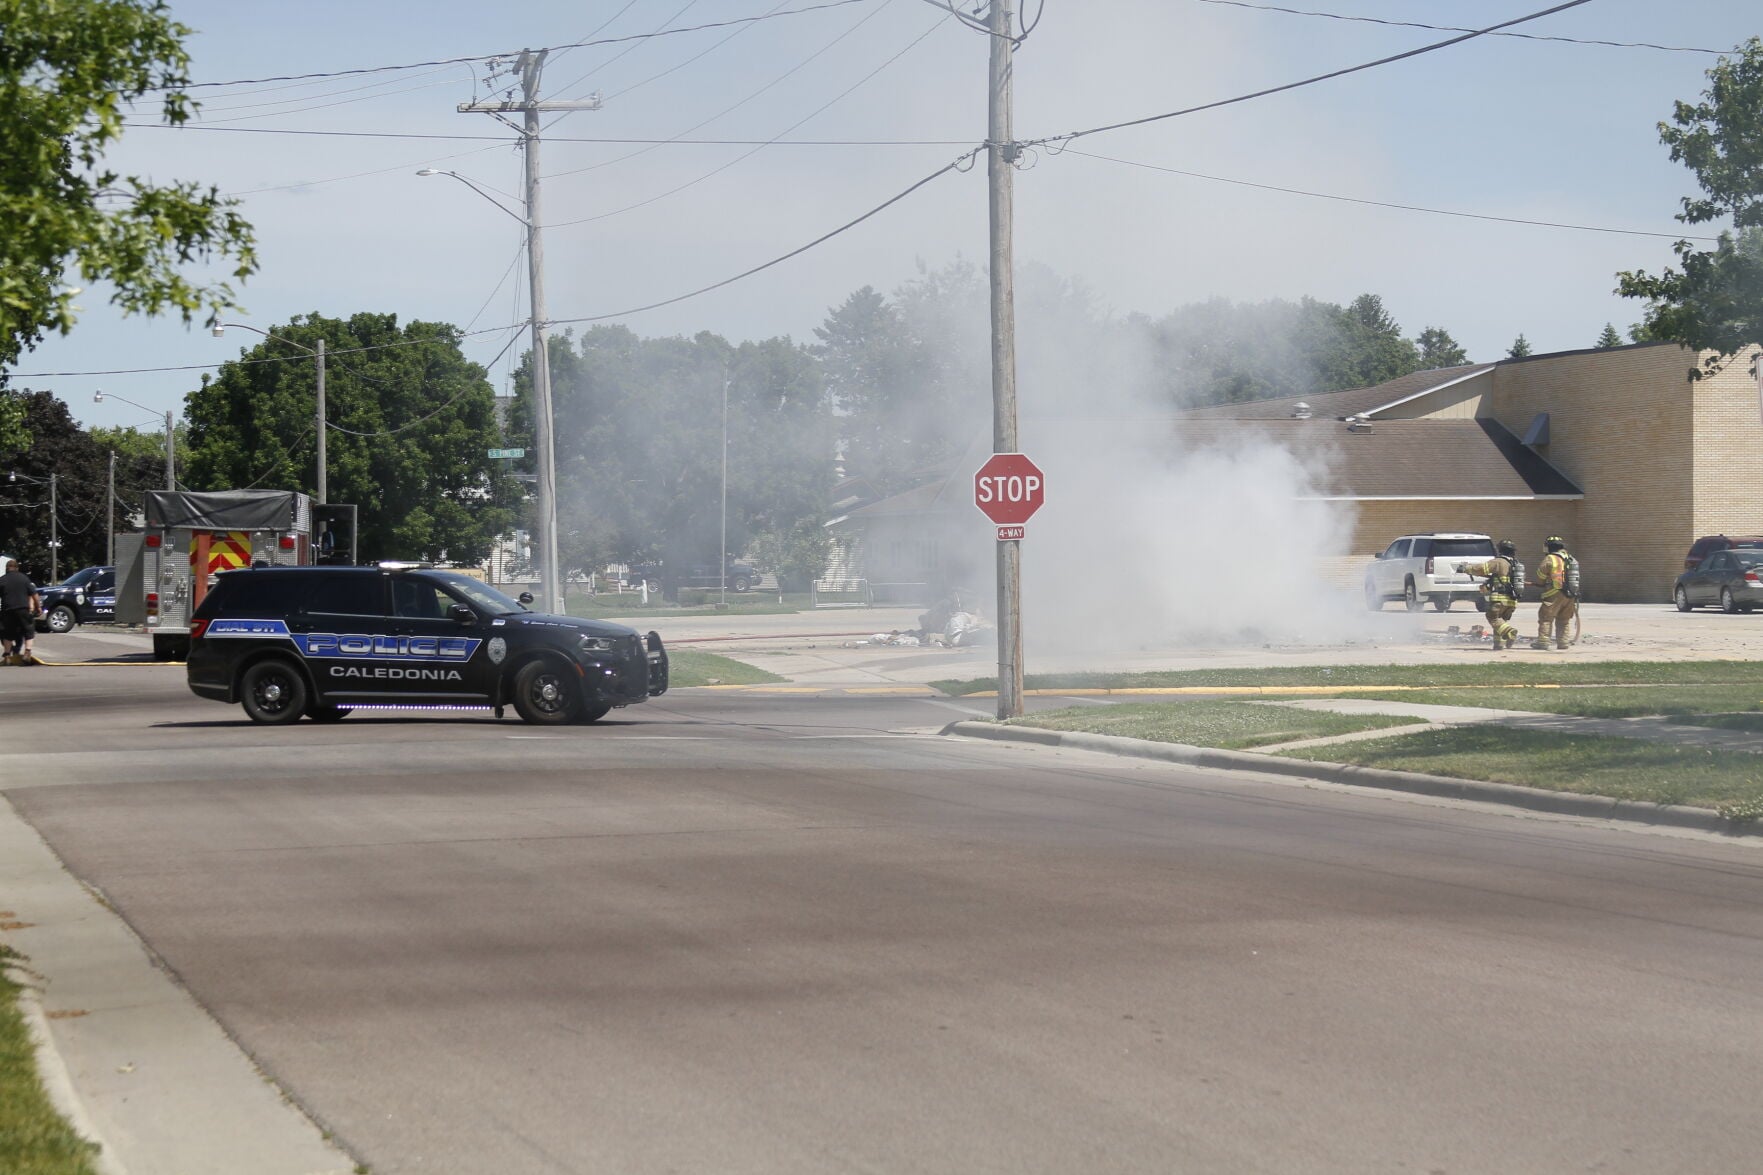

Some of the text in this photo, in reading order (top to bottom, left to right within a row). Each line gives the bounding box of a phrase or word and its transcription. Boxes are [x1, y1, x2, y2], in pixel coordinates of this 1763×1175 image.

[978, 475, 1040, 503] STOP
[999, 528, 1023, 538] 4-WAY
[215, 622, 275, 633] DIAL 911
[307, 633, 468, 657] POLICE
[329, 666, 462, 681] CALEDONIA
